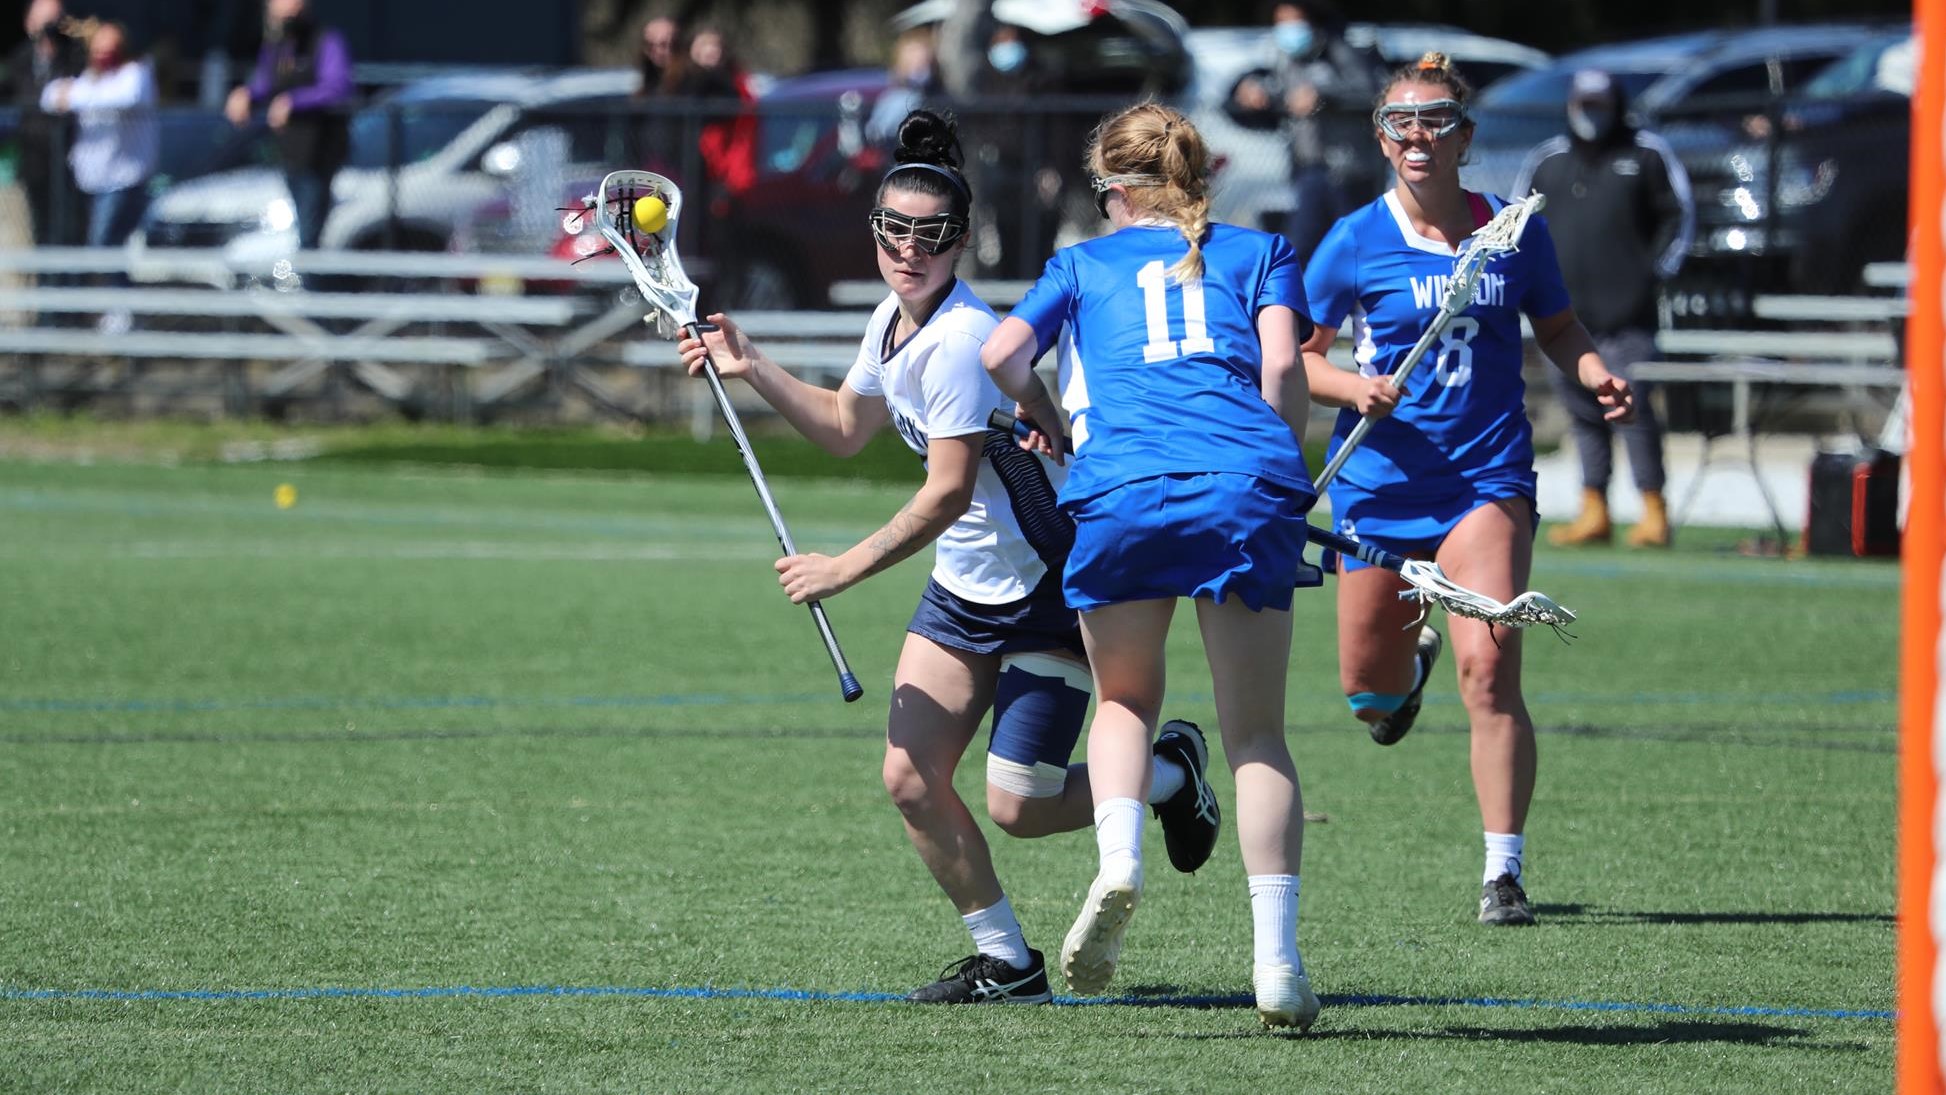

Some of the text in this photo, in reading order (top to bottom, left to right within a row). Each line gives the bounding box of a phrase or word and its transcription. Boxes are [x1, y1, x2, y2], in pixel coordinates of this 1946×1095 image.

[1136, 259, 1215, 364] 11
[1409, 272, 1506, 310] WION
[1436, 316, 1480, 387] 8
